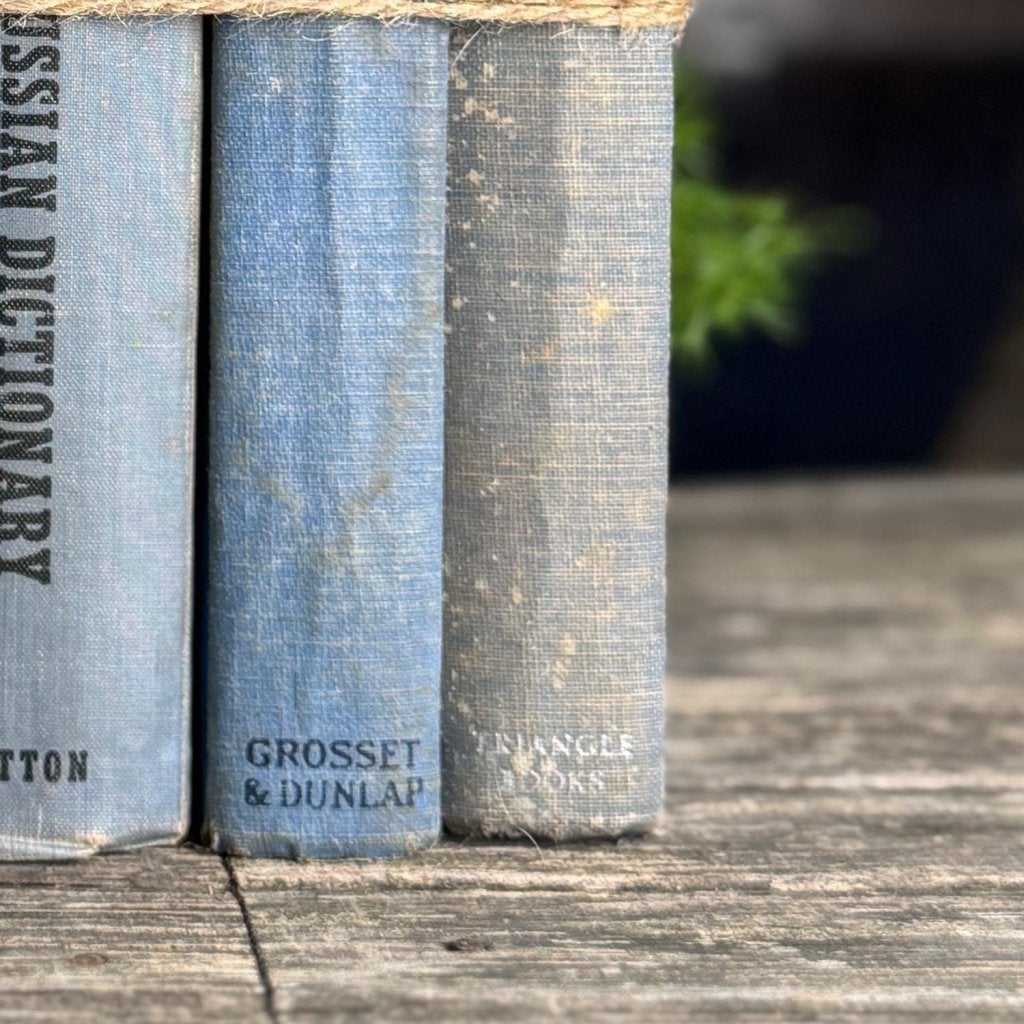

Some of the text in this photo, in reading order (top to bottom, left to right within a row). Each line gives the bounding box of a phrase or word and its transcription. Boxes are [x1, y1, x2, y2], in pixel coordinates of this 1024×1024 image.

[244, 738, 421, 770] GROSSET
[243, 776, 425, 810] & DUNLAP
